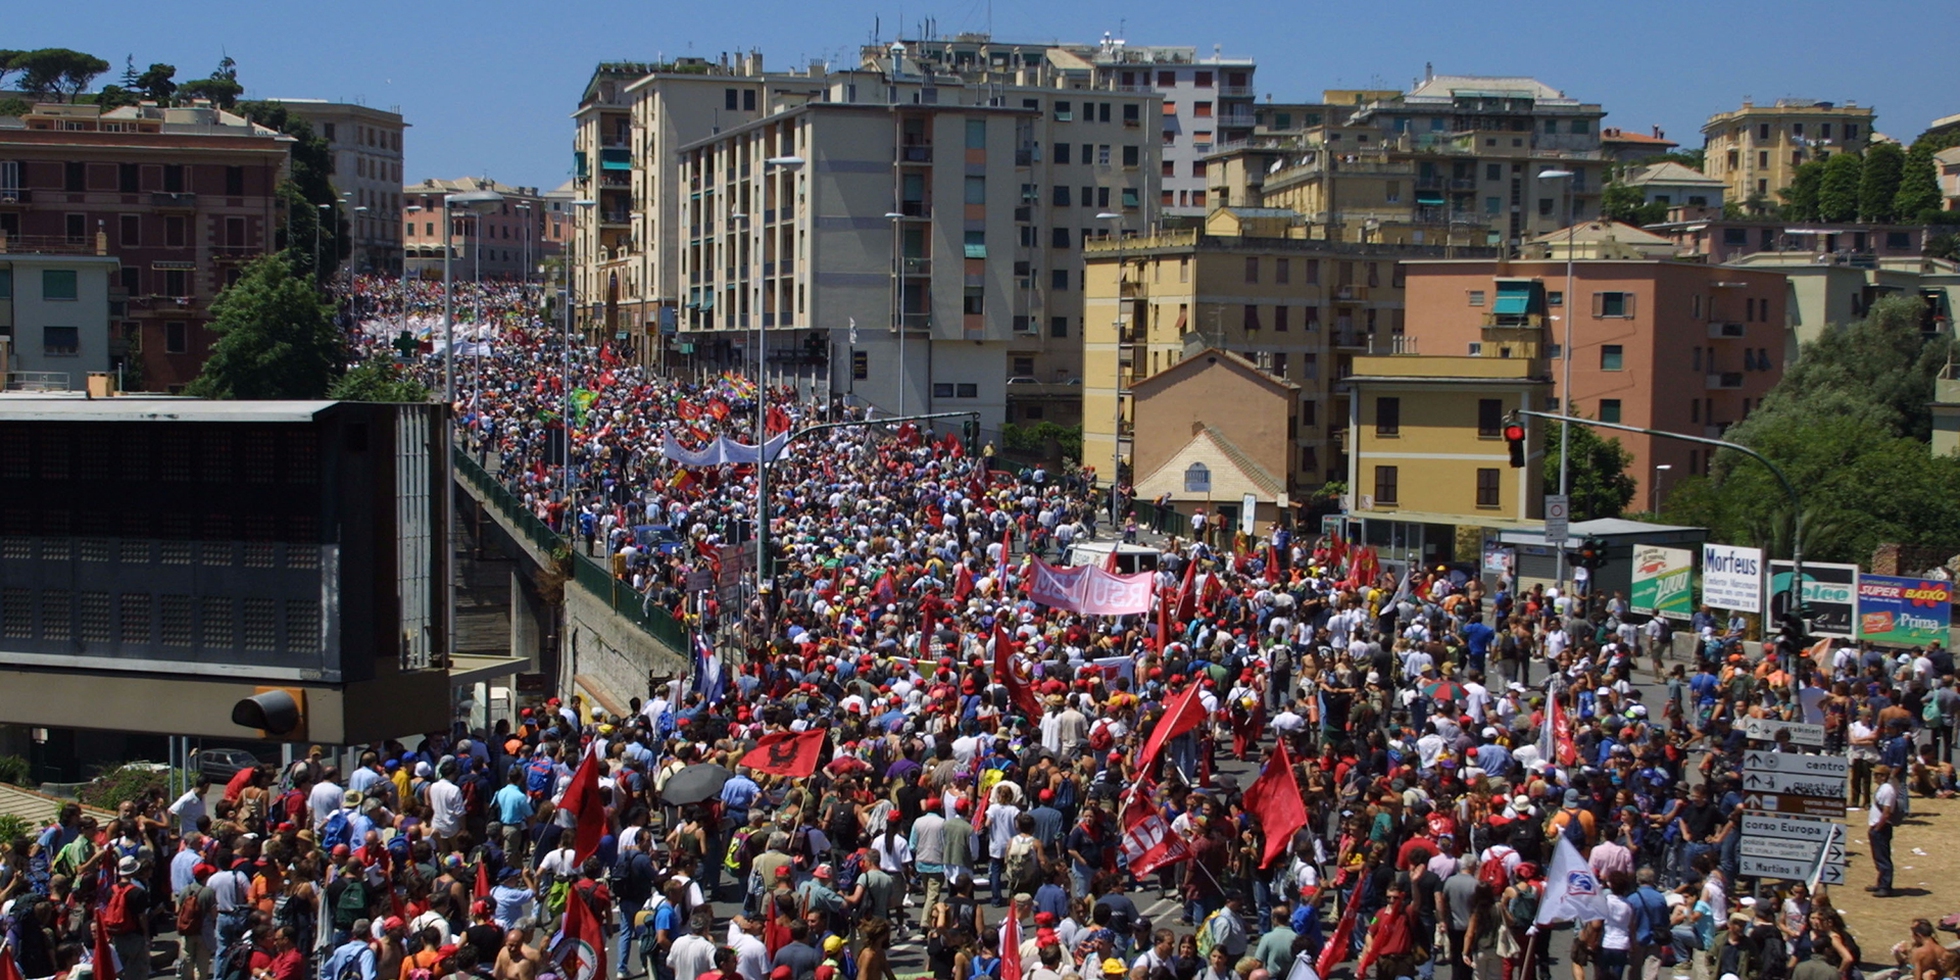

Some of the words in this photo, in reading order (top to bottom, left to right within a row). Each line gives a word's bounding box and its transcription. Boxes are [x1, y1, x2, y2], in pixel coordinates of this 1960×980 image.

[1705, 548, 1756, 576] Morfeus
[1859, 585, 1900, 598] SUPER
[1904, 588, 1947, 601] BASKO
[1900, 612, 1938, 630] Prima
[1806, 761, 1845, 772] centro
[1745, 820, 1776, 831] corso
[1781, 822, 1821, 835] Europa
[1743, 862, 1751, 872] S.
[1756, 862, 1790, 874] Martino
